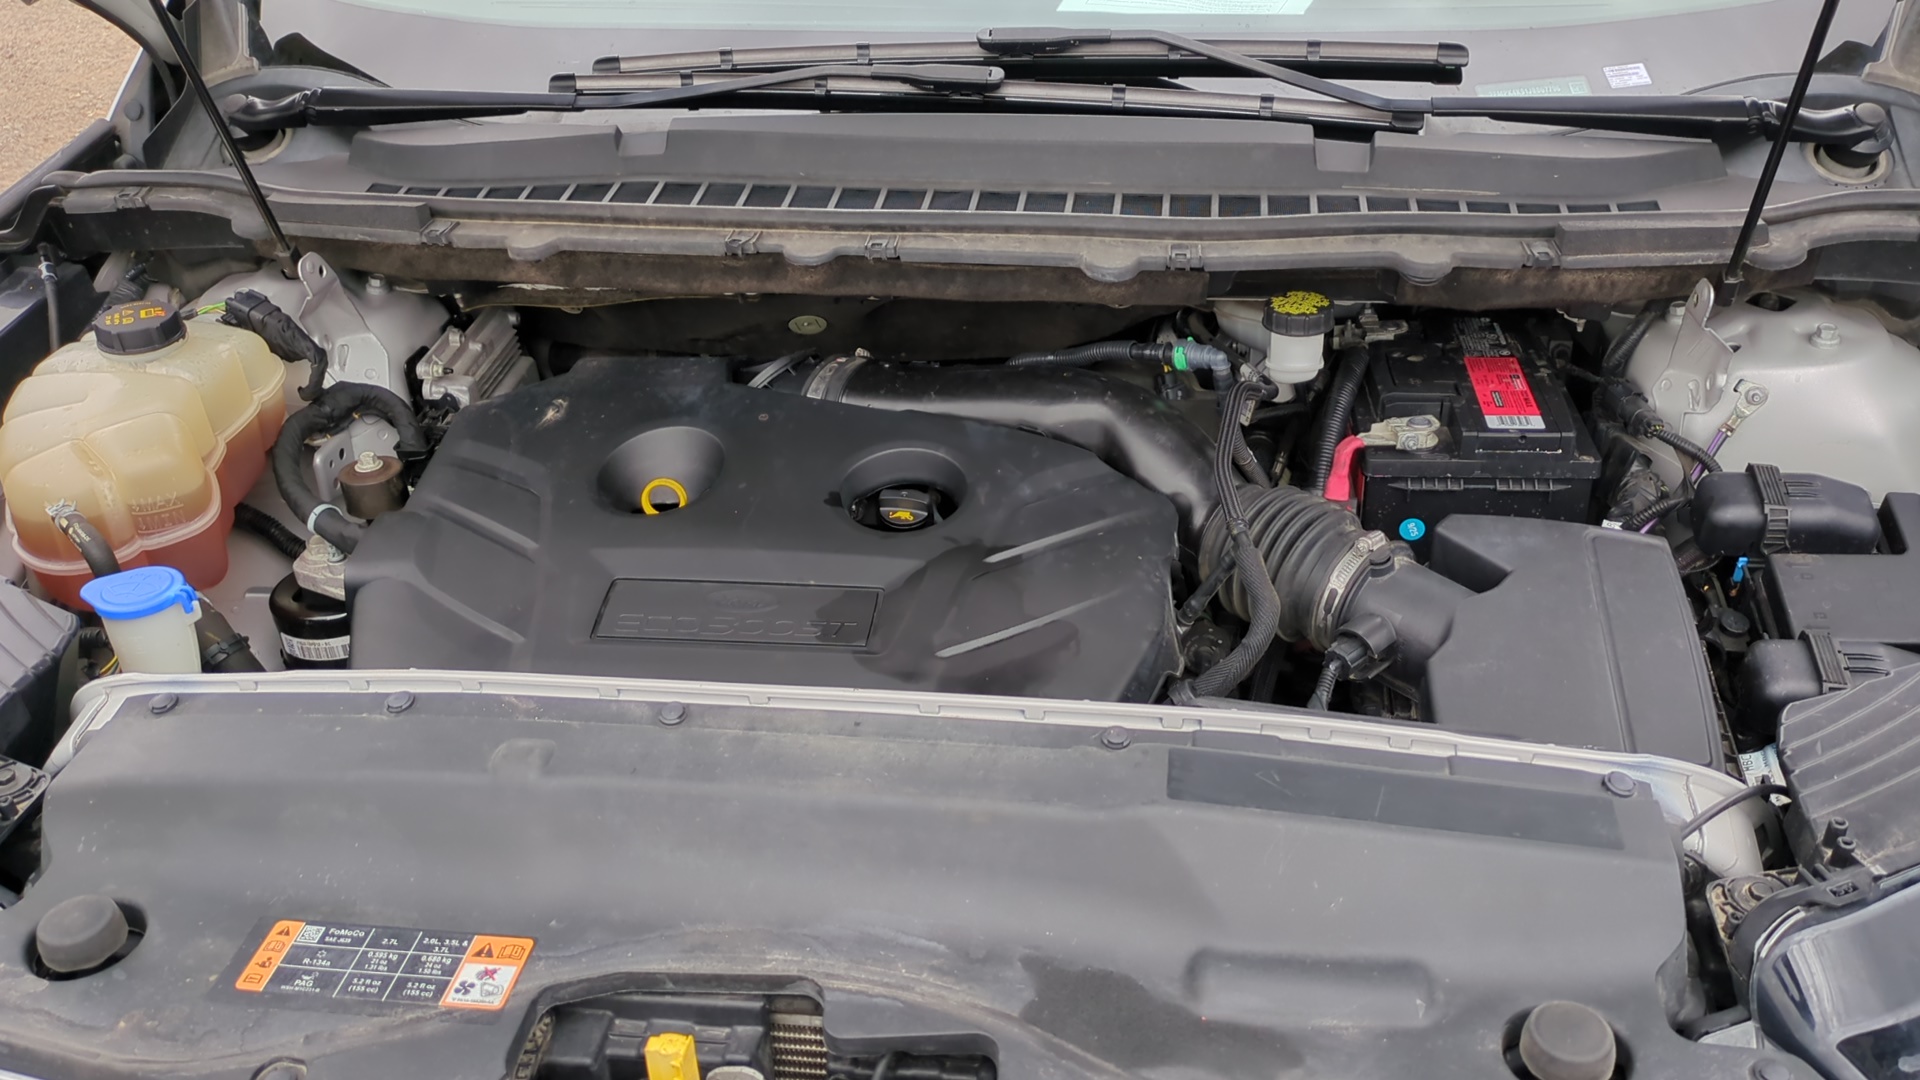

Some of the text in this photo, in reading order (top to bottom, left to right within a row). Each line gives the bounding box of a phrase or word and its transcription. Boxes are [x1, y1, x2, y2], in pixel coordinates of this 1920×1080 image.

[328, 927, 366, 937] FoMoCo
[381, 938, 399, 946] 2.7L
[388, 952, 399, 961] kg
[441, 956, 452, 965] kg
[302, 957, 331, 967] R-134a
[293, 979, 314, 987] PAG
[347, 984, 379, 994] (155 cc)
[402, 988, 434, 998] (155 cc)
